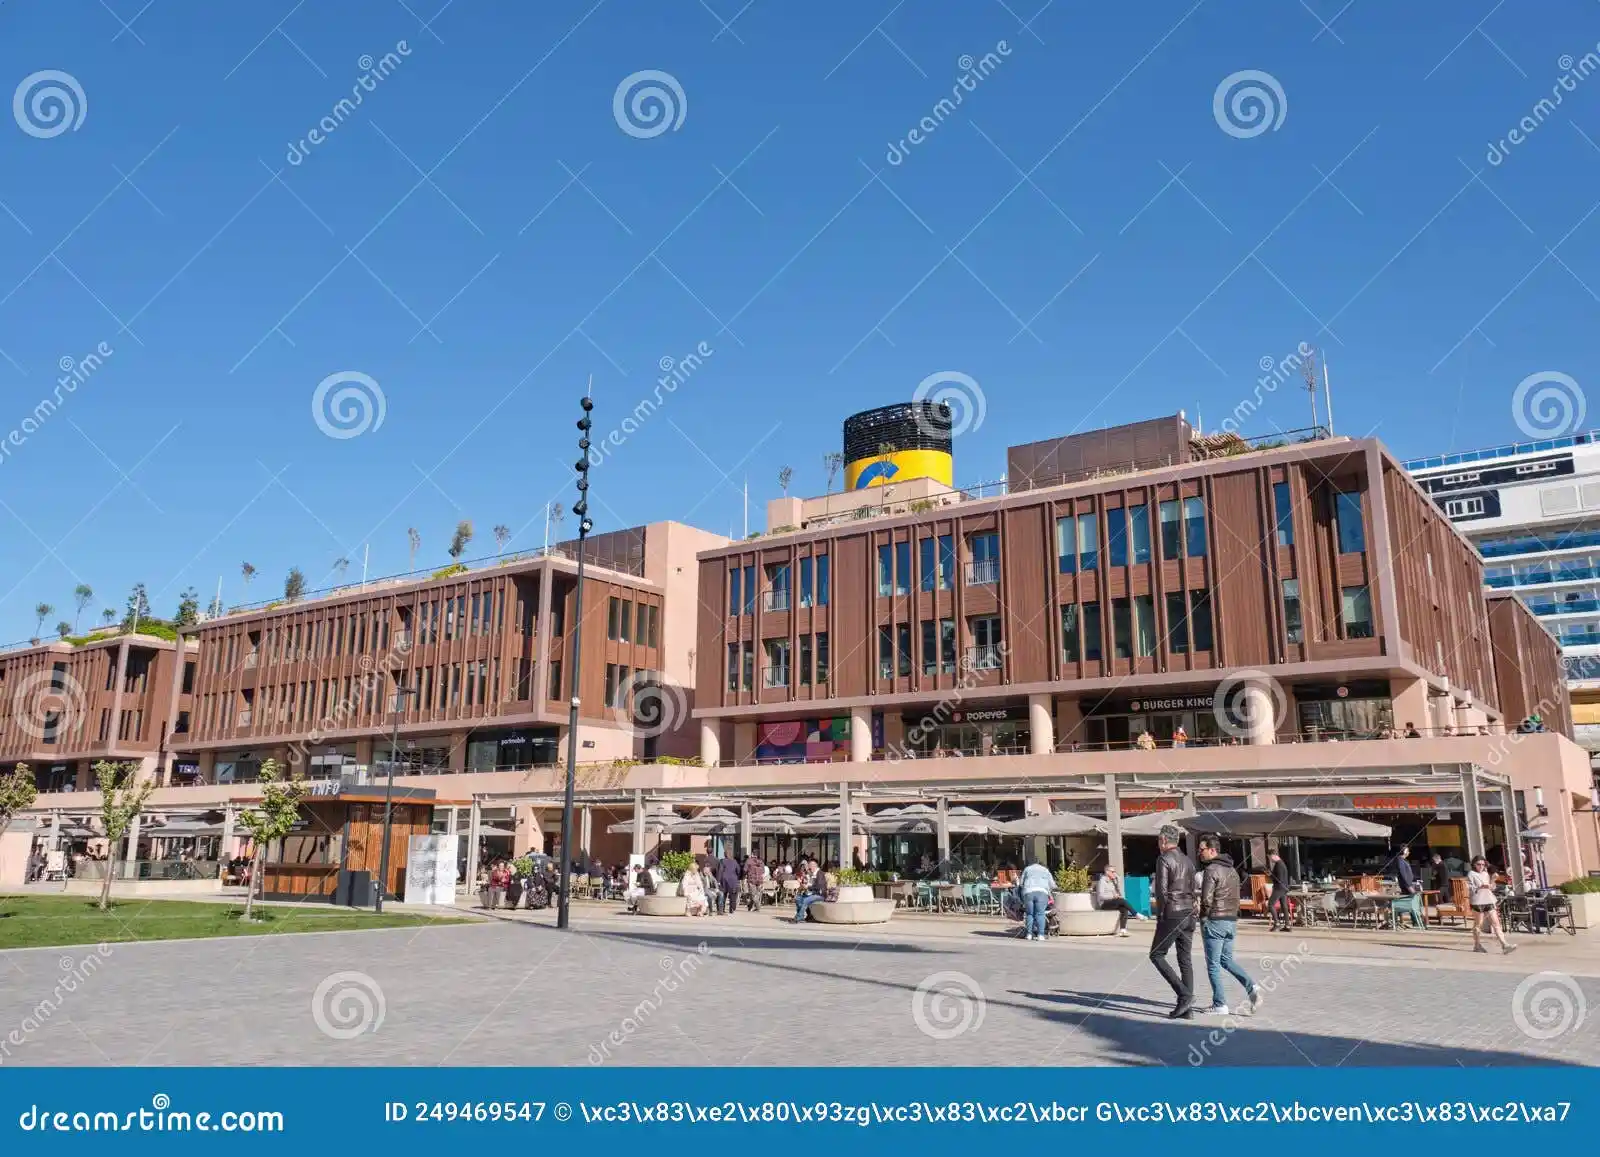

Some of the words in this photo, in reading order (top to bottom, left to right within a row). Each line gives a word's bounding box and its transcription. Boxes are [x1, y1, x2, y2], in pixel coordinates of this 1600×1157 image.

[1143, 698, 1184, 710] BURGER
[1186, 697, 1213, 708] KING
[312, 782, 340, 796] INFO
